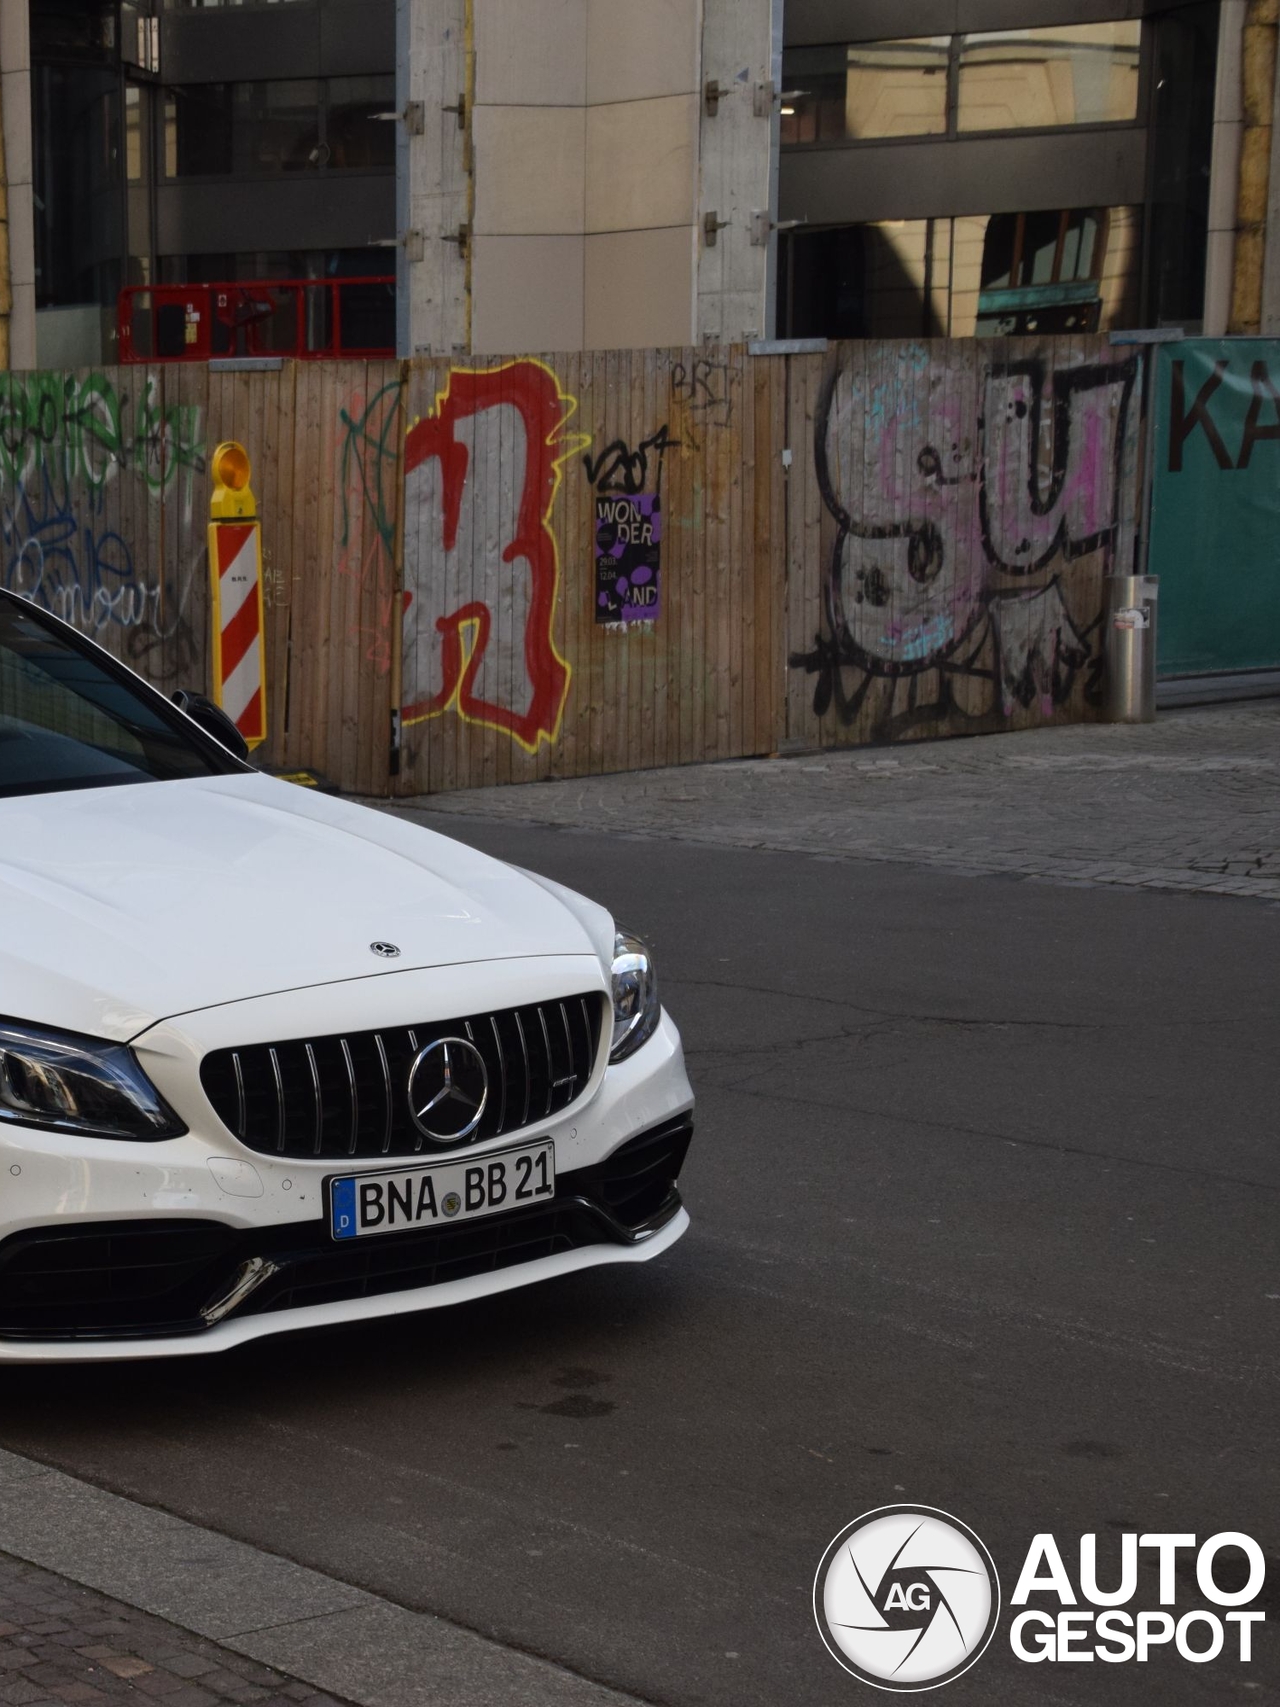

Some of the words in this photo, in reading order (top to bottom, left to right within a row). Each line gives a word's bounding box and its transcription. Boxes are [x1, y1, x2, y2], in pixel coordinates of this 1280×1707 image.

[598, 500, 641, 523] WON
[617, 522, 653, 546] DER
[340, 1215, 349, 1229] D
[359, 1175, 438, 1228] BNA
[465, 1160, 507, 1212] BB
[515, 1150, 552, 1200] 21
